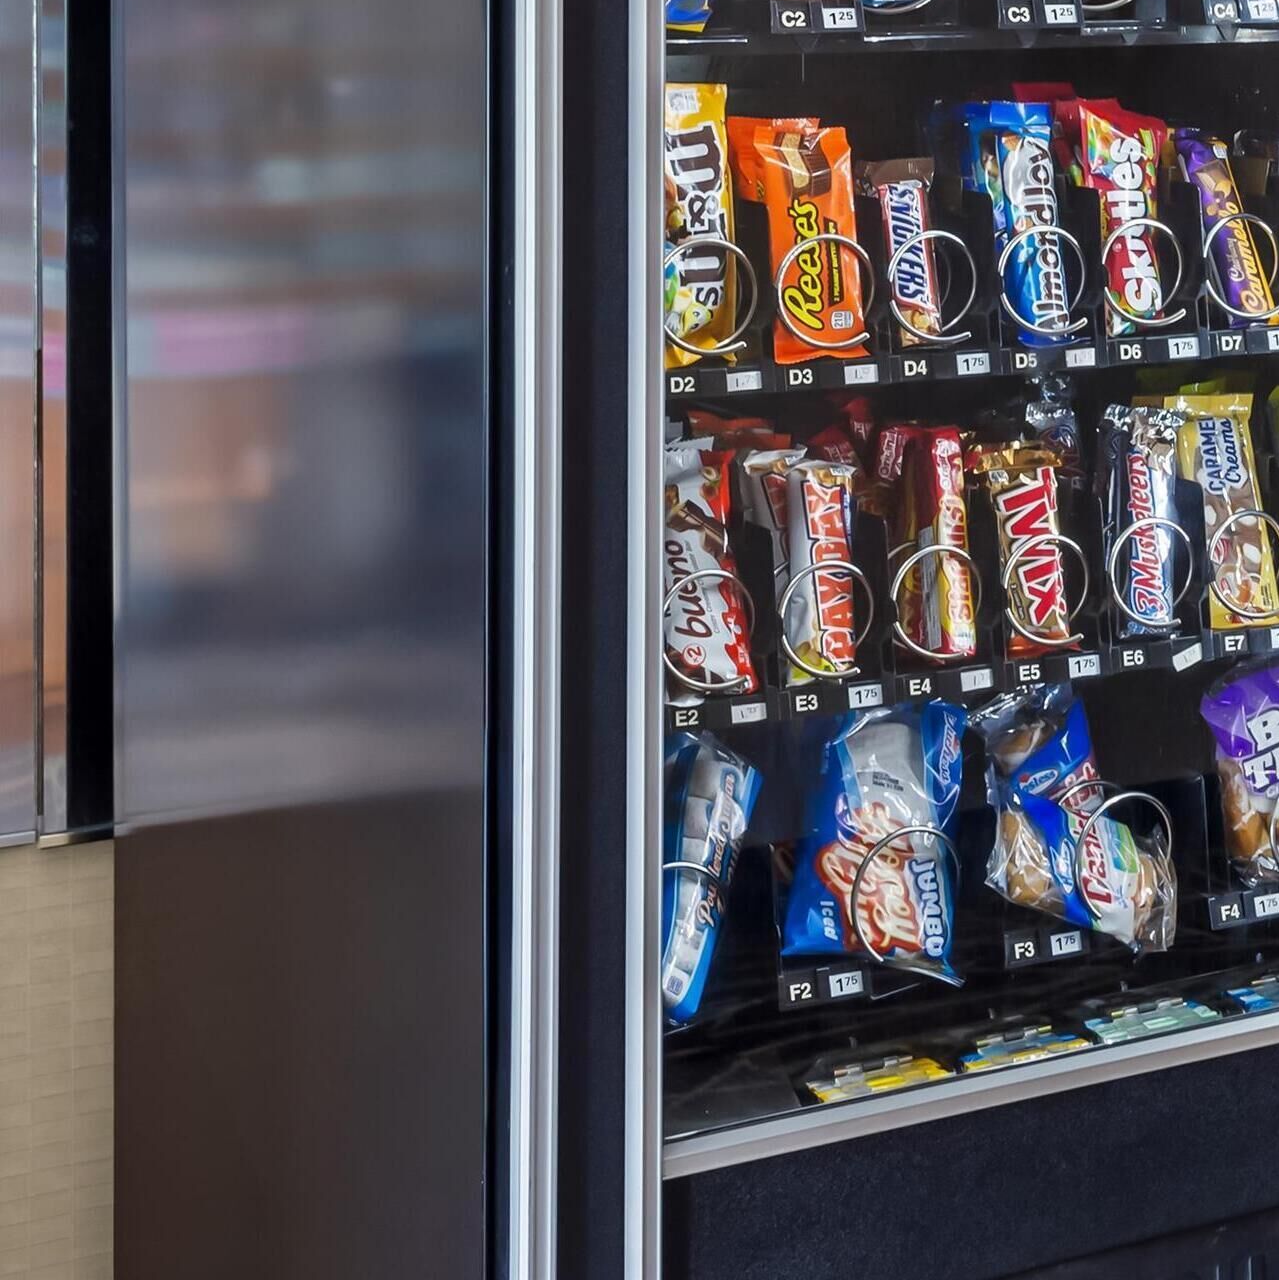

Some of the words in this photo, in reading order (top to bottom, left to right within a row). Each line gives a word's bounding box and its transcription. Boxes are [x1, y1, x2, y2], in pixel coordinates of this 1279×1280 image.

[781, 10, 806, 27] C2
[1008, 6, 1031, 22] C3
[1213, 3, 1236, 18] C4
[1110, 136, 1162, 311] Skittles
[888, 183, 929, 306] SNICKERS
[1221, 335, 1242, 351] D7
[1120, 345, 1142, 360] D6
[904, 360, 927, 376] D4
[1015, 353, 1037, 369] D5
[670, 376, 695, 393] D2
[789, 368, 813, 385] D3
[1222, 418, 1241, 484] Creams
[1128, 454, 1163, 591] Musketeers
[1003, 467, 1066, 626] TWIX
[1224, 635, 1244, 651] E7
[1123, 650, 1144, 666] E6
[1019, 664, 1041, 680] E5
[909, 680, 932, 695] E4
[795, 695, 818, 711] E3
[675, 711, 699, 727] E2
[911, 857, 945, 958] JUMBO
[1221, 904, 1240, 920] F4
[1014, 941, 1035, 959] F3
[789, 983, 812, 1001] F2
